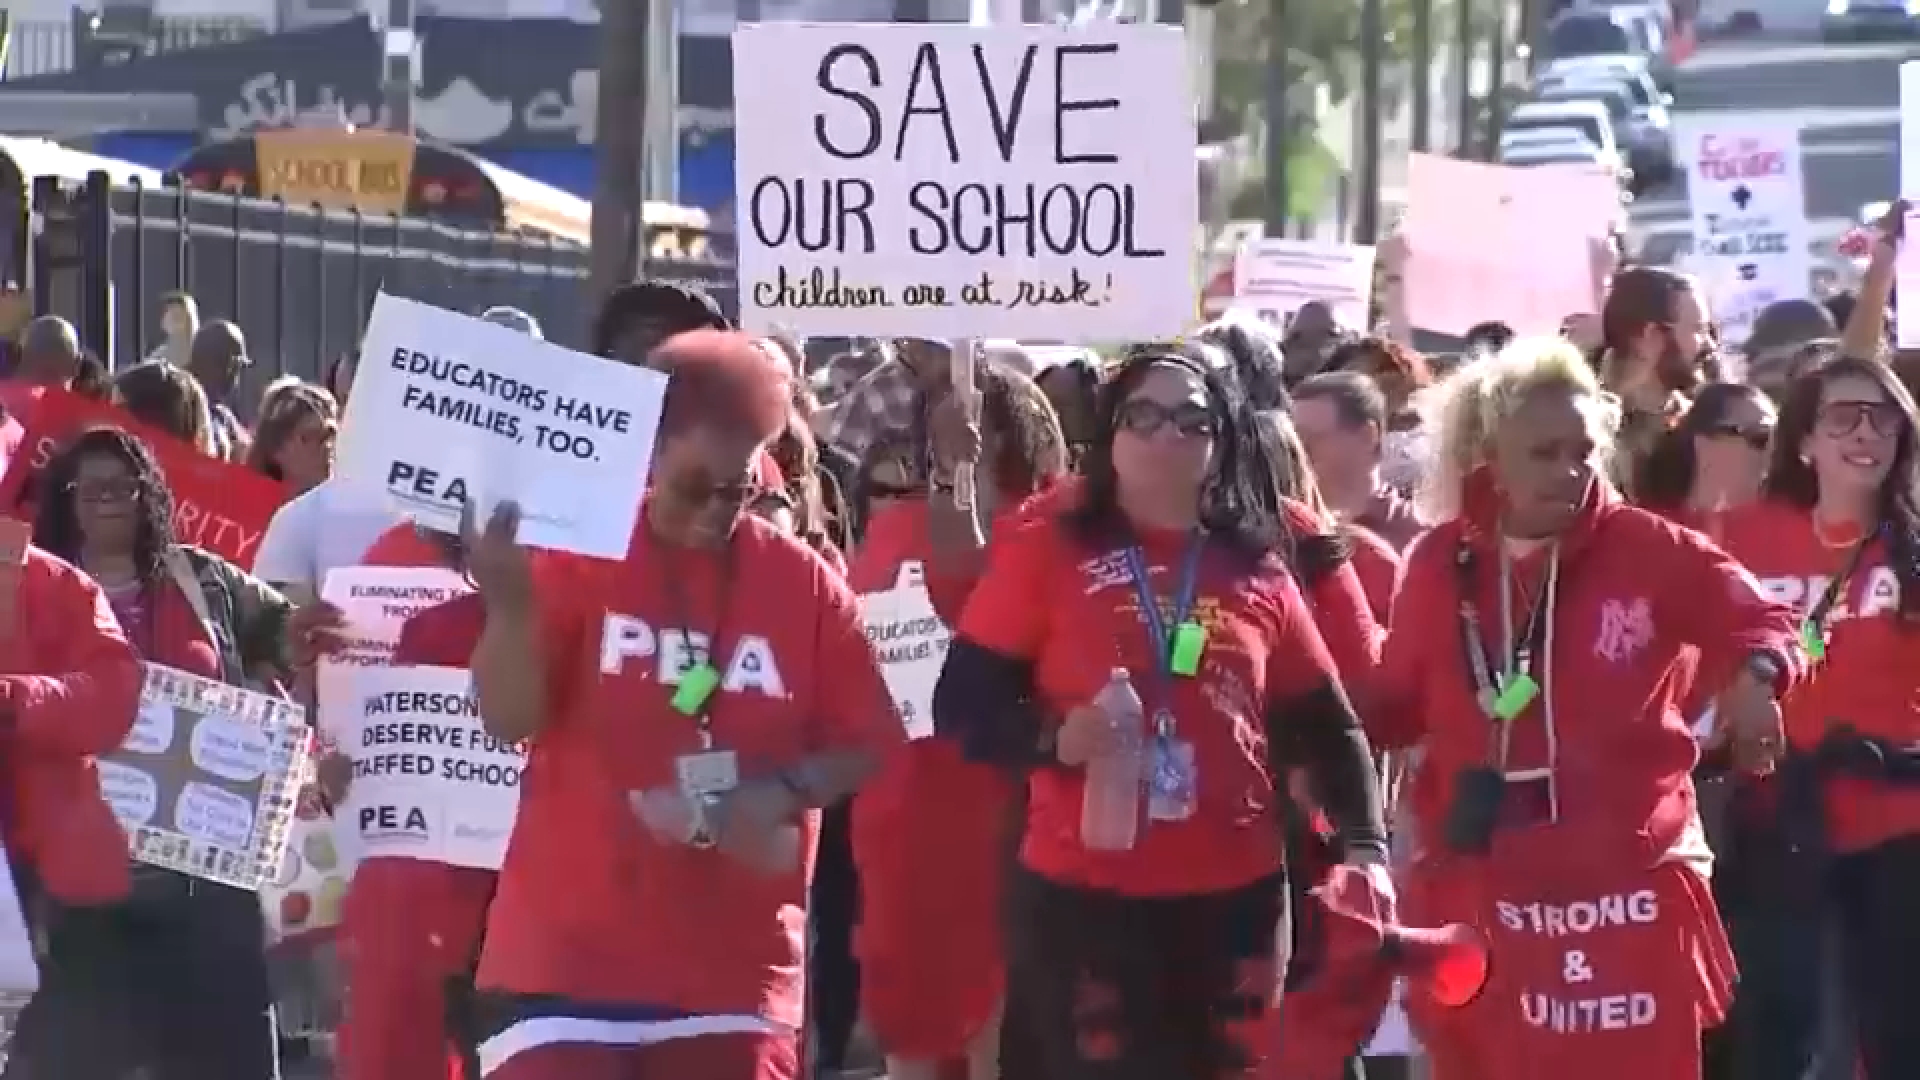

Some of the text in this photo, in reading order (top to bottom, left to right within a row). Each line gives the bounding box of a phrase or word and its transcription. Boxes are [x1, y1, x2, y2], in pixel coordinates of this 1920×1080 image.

[814, 41, 1120, 163] SAVE
[751, 176, 1165, 257] OUR SCHOOL
[753, 266, 1114, 309] children are at risk!
[390, 346, 632, 434] EDUCATORS HAVE
[402, 383, 600, 462] FAMILIES, TOO.
[387, 459, 467, 503] PEA
[600, 610, 788, 699] PEA
[364, 691, 480, 718] PATERSON
[362, 723, 464, 749] DESERVE
[352, 754, 519, 787] TAFFED SCHOO
[358, 806, 428, 832] PEA
[1496, 889, 1659, 938] STRONG
[1562, 949, 1594, 984] &
[1519, 990, 1657, 1034] UNITED
